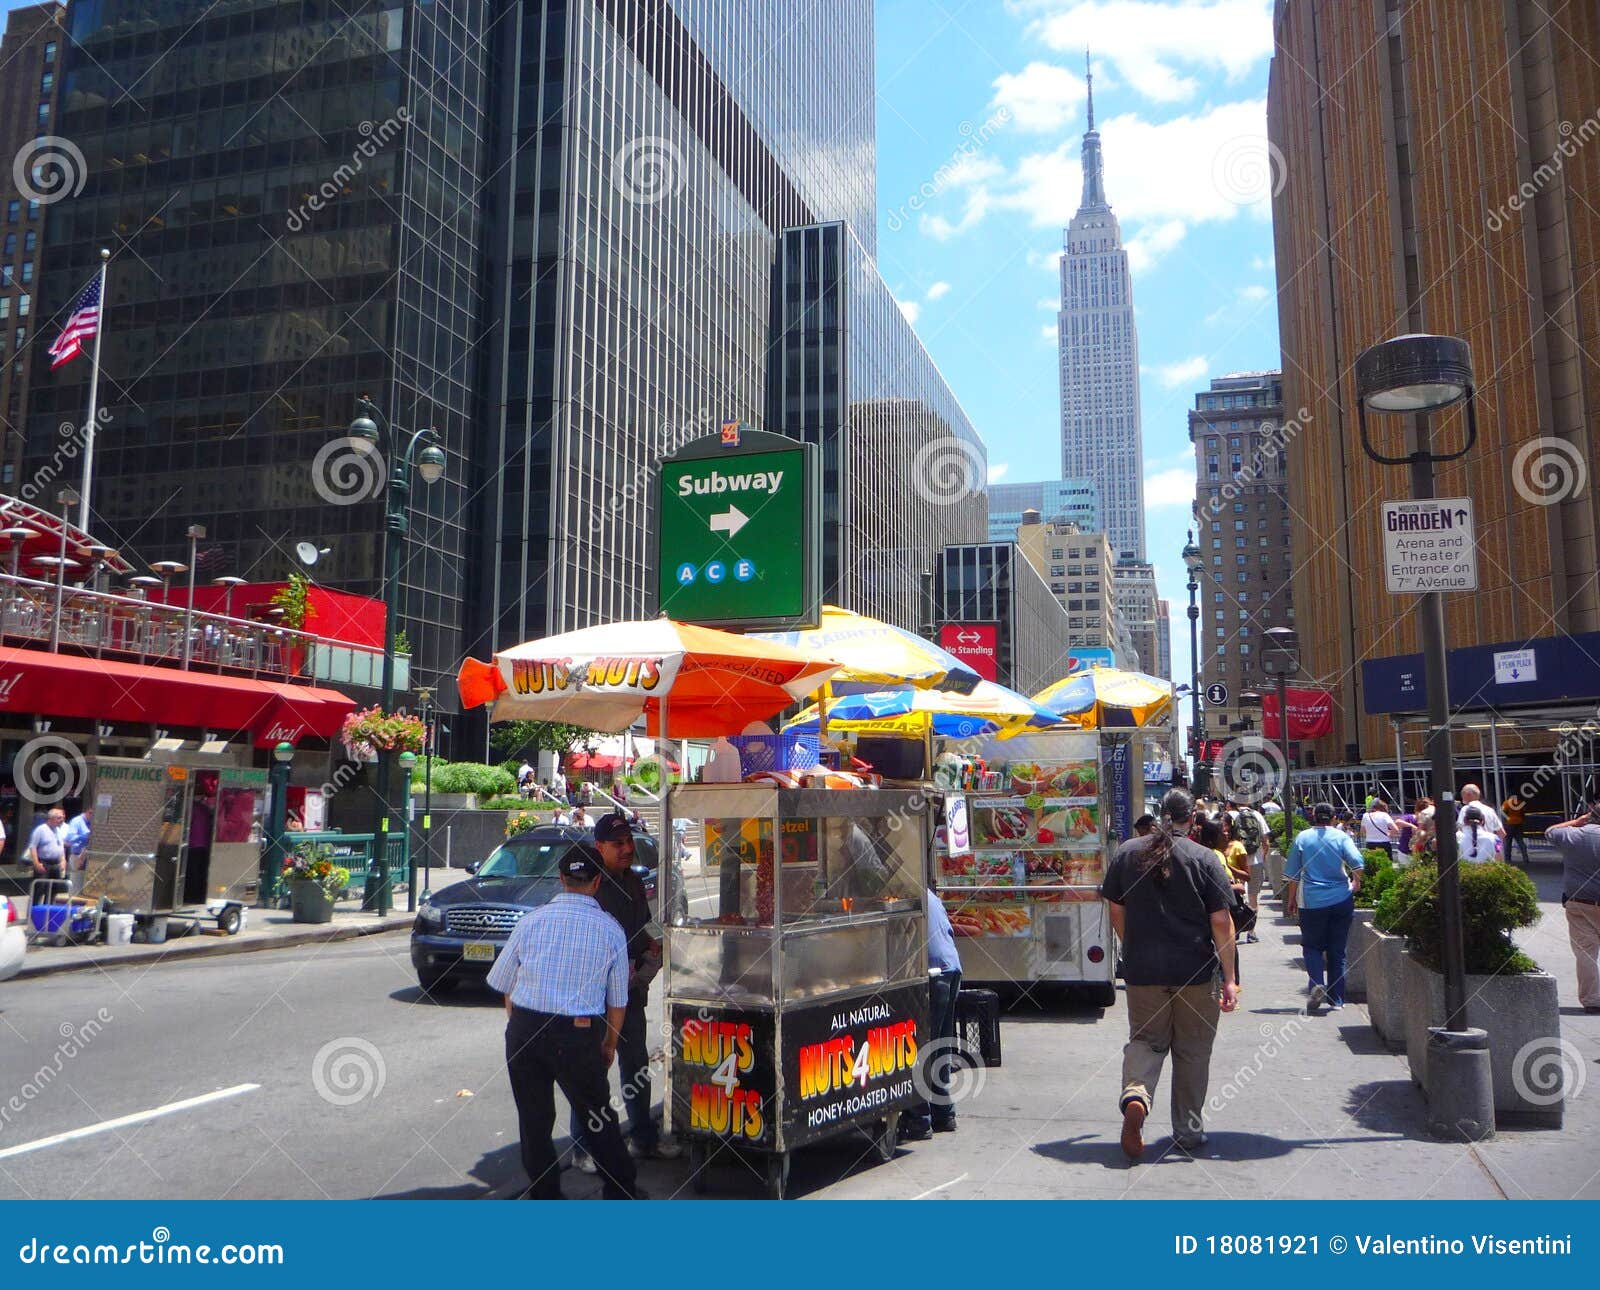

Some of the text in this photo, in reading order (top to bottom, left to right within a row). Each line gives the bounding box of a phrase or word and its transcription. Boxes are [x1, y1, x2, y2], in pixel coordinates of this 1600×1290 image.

[678, 470, 784, 497] Subway
[1387, 508, 1452, 531] GARDEN
[1396, 536, 1463, 549] Arena and
[1400, 550, 1460, 562] Theater
[679, 562, 750, 581] A C E
[1392, 563, 1470, 576] Entrance on
[1416, 576, 1466, 588] Avenue
[808, 627, 890, 649] SABRETT
[944, 645, 993, 656] No Standing
[511, 656, 573, 695] NUTS
[587, 655, 663, 690] NUTS
[264, 720, 305, 742] local
[99, 766, 130, 781] FRUIT
[131, 767, 163, 782] JUICE
[1112, 762, 1125, 802] Bicycle
[830, 1003, 891, 1031] ALL NATURAL
[683, 1016, 755, 1073] NUTS
[799, 1019, 920, 1100] NUTS 4 NUTS
[711, 1053, 741, 1098] 4
[690, 1083, 765, 1141] NUTS
[808, 1078, 914, 1128] HONEY-ROASTED NUTS
